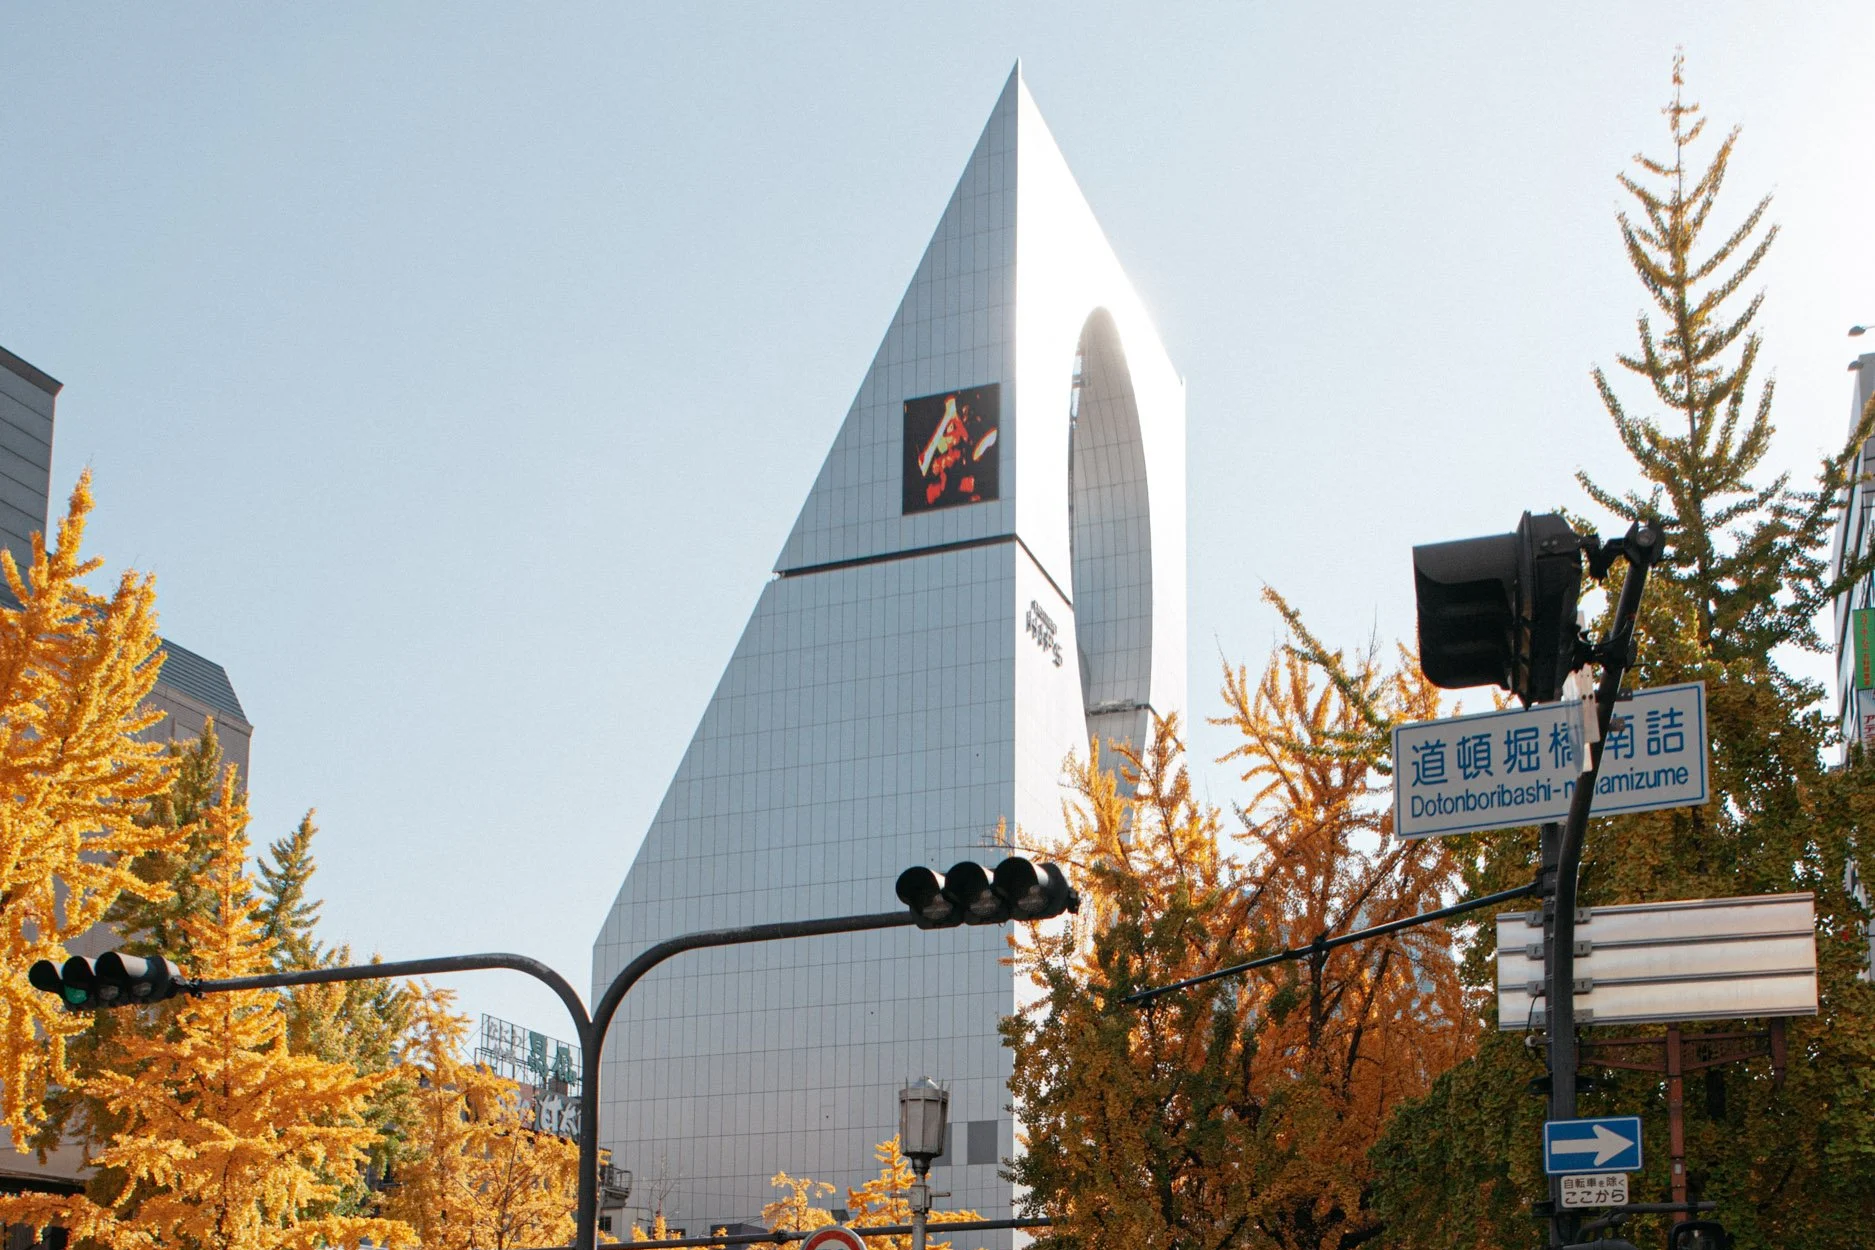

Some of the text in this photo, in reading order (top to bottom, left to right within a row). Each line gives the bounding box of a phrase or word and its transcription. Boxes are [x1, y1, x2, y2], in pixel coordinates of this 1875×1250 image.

[1564, 1176, 1625, 1189] 自転車を除く
[1565, 1189, 1625, 1204] ここから
